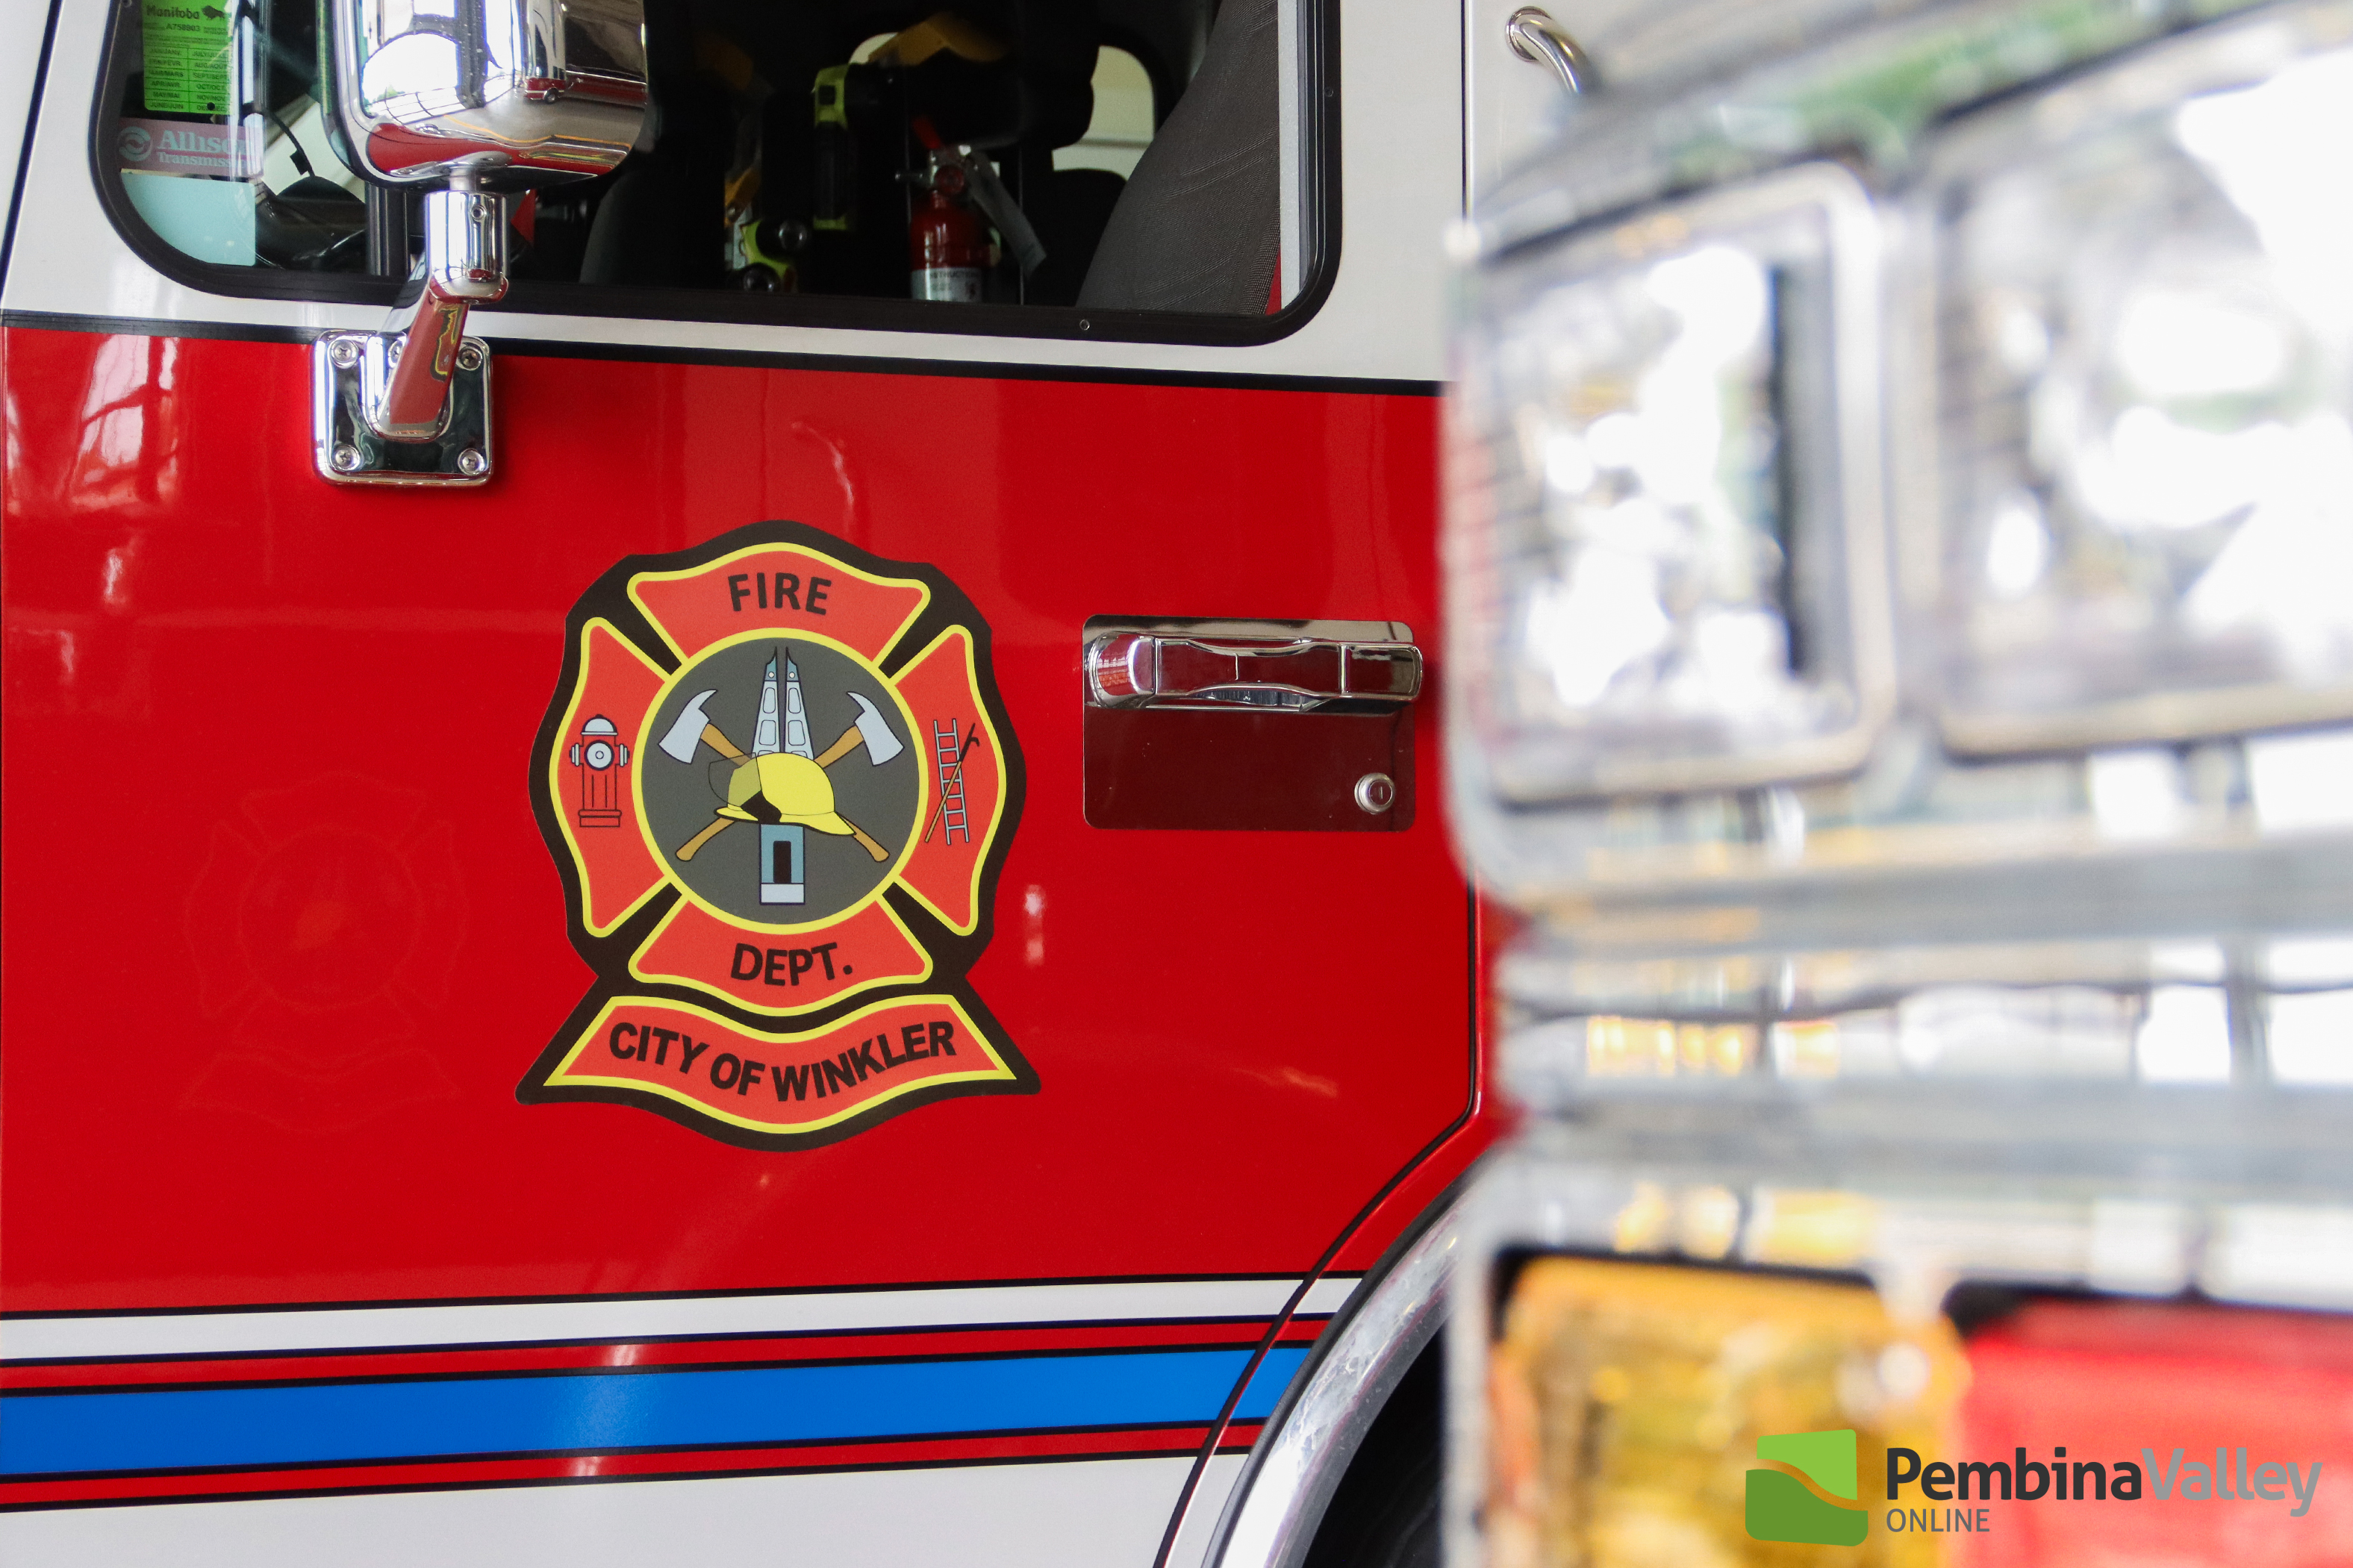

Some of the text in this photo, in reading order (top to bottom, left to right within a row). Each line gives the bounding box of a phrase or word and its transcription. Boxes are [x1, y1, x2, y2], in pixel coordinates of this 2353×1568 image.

[146, 4, 200, 19] Manitoba
[728, 572, 832, 616] FIRE
[730, 942, 853, 987] DEPT.
[609, 1021, 957, 1102] CITY OF WINKLER
